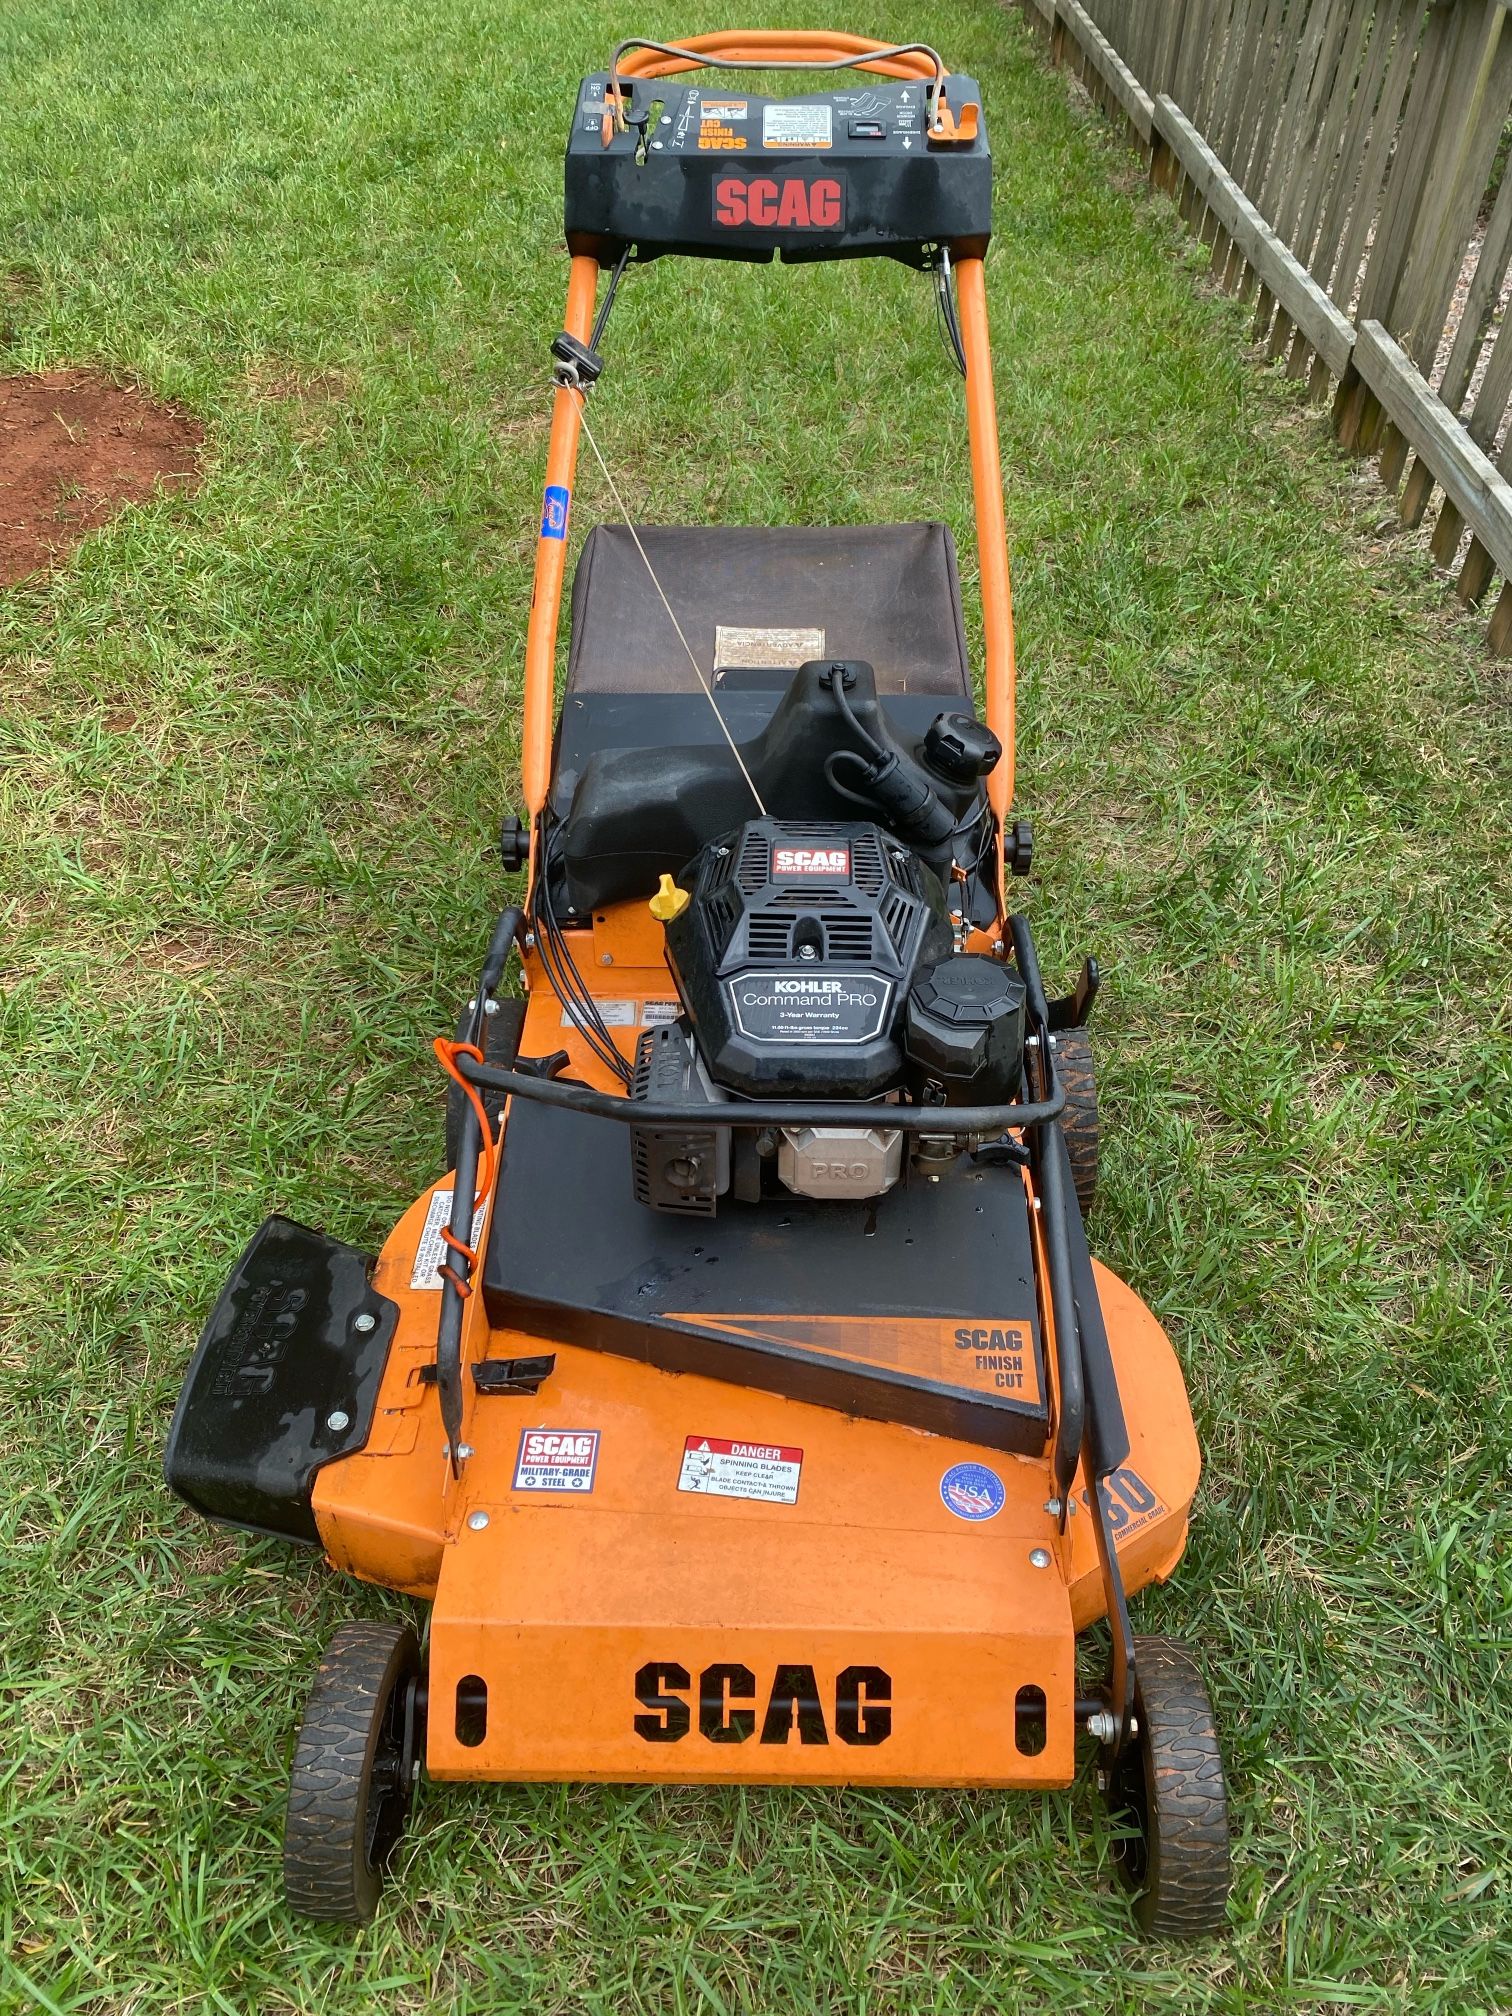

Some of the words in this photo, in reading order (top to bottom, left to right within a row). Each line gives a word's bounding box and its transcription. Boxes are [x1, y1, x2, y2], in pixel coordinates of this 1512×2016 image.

[700, 119, 721, 128] CUT
[700, 128, 733, 137] FINISH
[698, 137, 748, 150] SCAG
[716, 178, 841, 227] SCAG
[776, 851, 847, 866] SCAG
[804, 865, 846, 873] EQUIPMENT
[743, 993, 832, 1006] Command
[837, 993, 877, 1006] PRO
[805, 1012, 840, 1020] Warranty
[811, 1161, 870, 1181] PRO
[954, 1328, 1023, 1351] SCAG
[975, 1355, 1023, 1371] FINISH
[995, 1372, 1024, 1388] CUT
[527, 1435, 592, 1456] SCAG
[731, 1444, 781, 1460] DANGER
[525, 1455, 549, 1464] POWER
[550, 1455, 589, 1465] EQUIPMENT
[719, 1458, 759, 1469] SPINNING
[760, 1462, 793, 1473] BLADES
[520, 1467, 591, 1478] MILITARY-GRADE
[753, 1472, 774, 1480] CLEAR
[541, 1478, 566, 1487] STEEL
[710, 1476, 731, 1484] BLADE
[732, 1478, 760, 1487] CONTACT
[768, 1483, 796, 1492] THROWN
[718, 1484, 747, 1493] OBJECTS
[762, 1489, 786, 1498] INJURE
[955, 1483, 991, 1500] USA
[1114, 1516, 1148, 1541] COMMERCIAL
[1147, 1505, 1166, 1520] GRADE
[634, 1662, 892, 1746] SCAG
